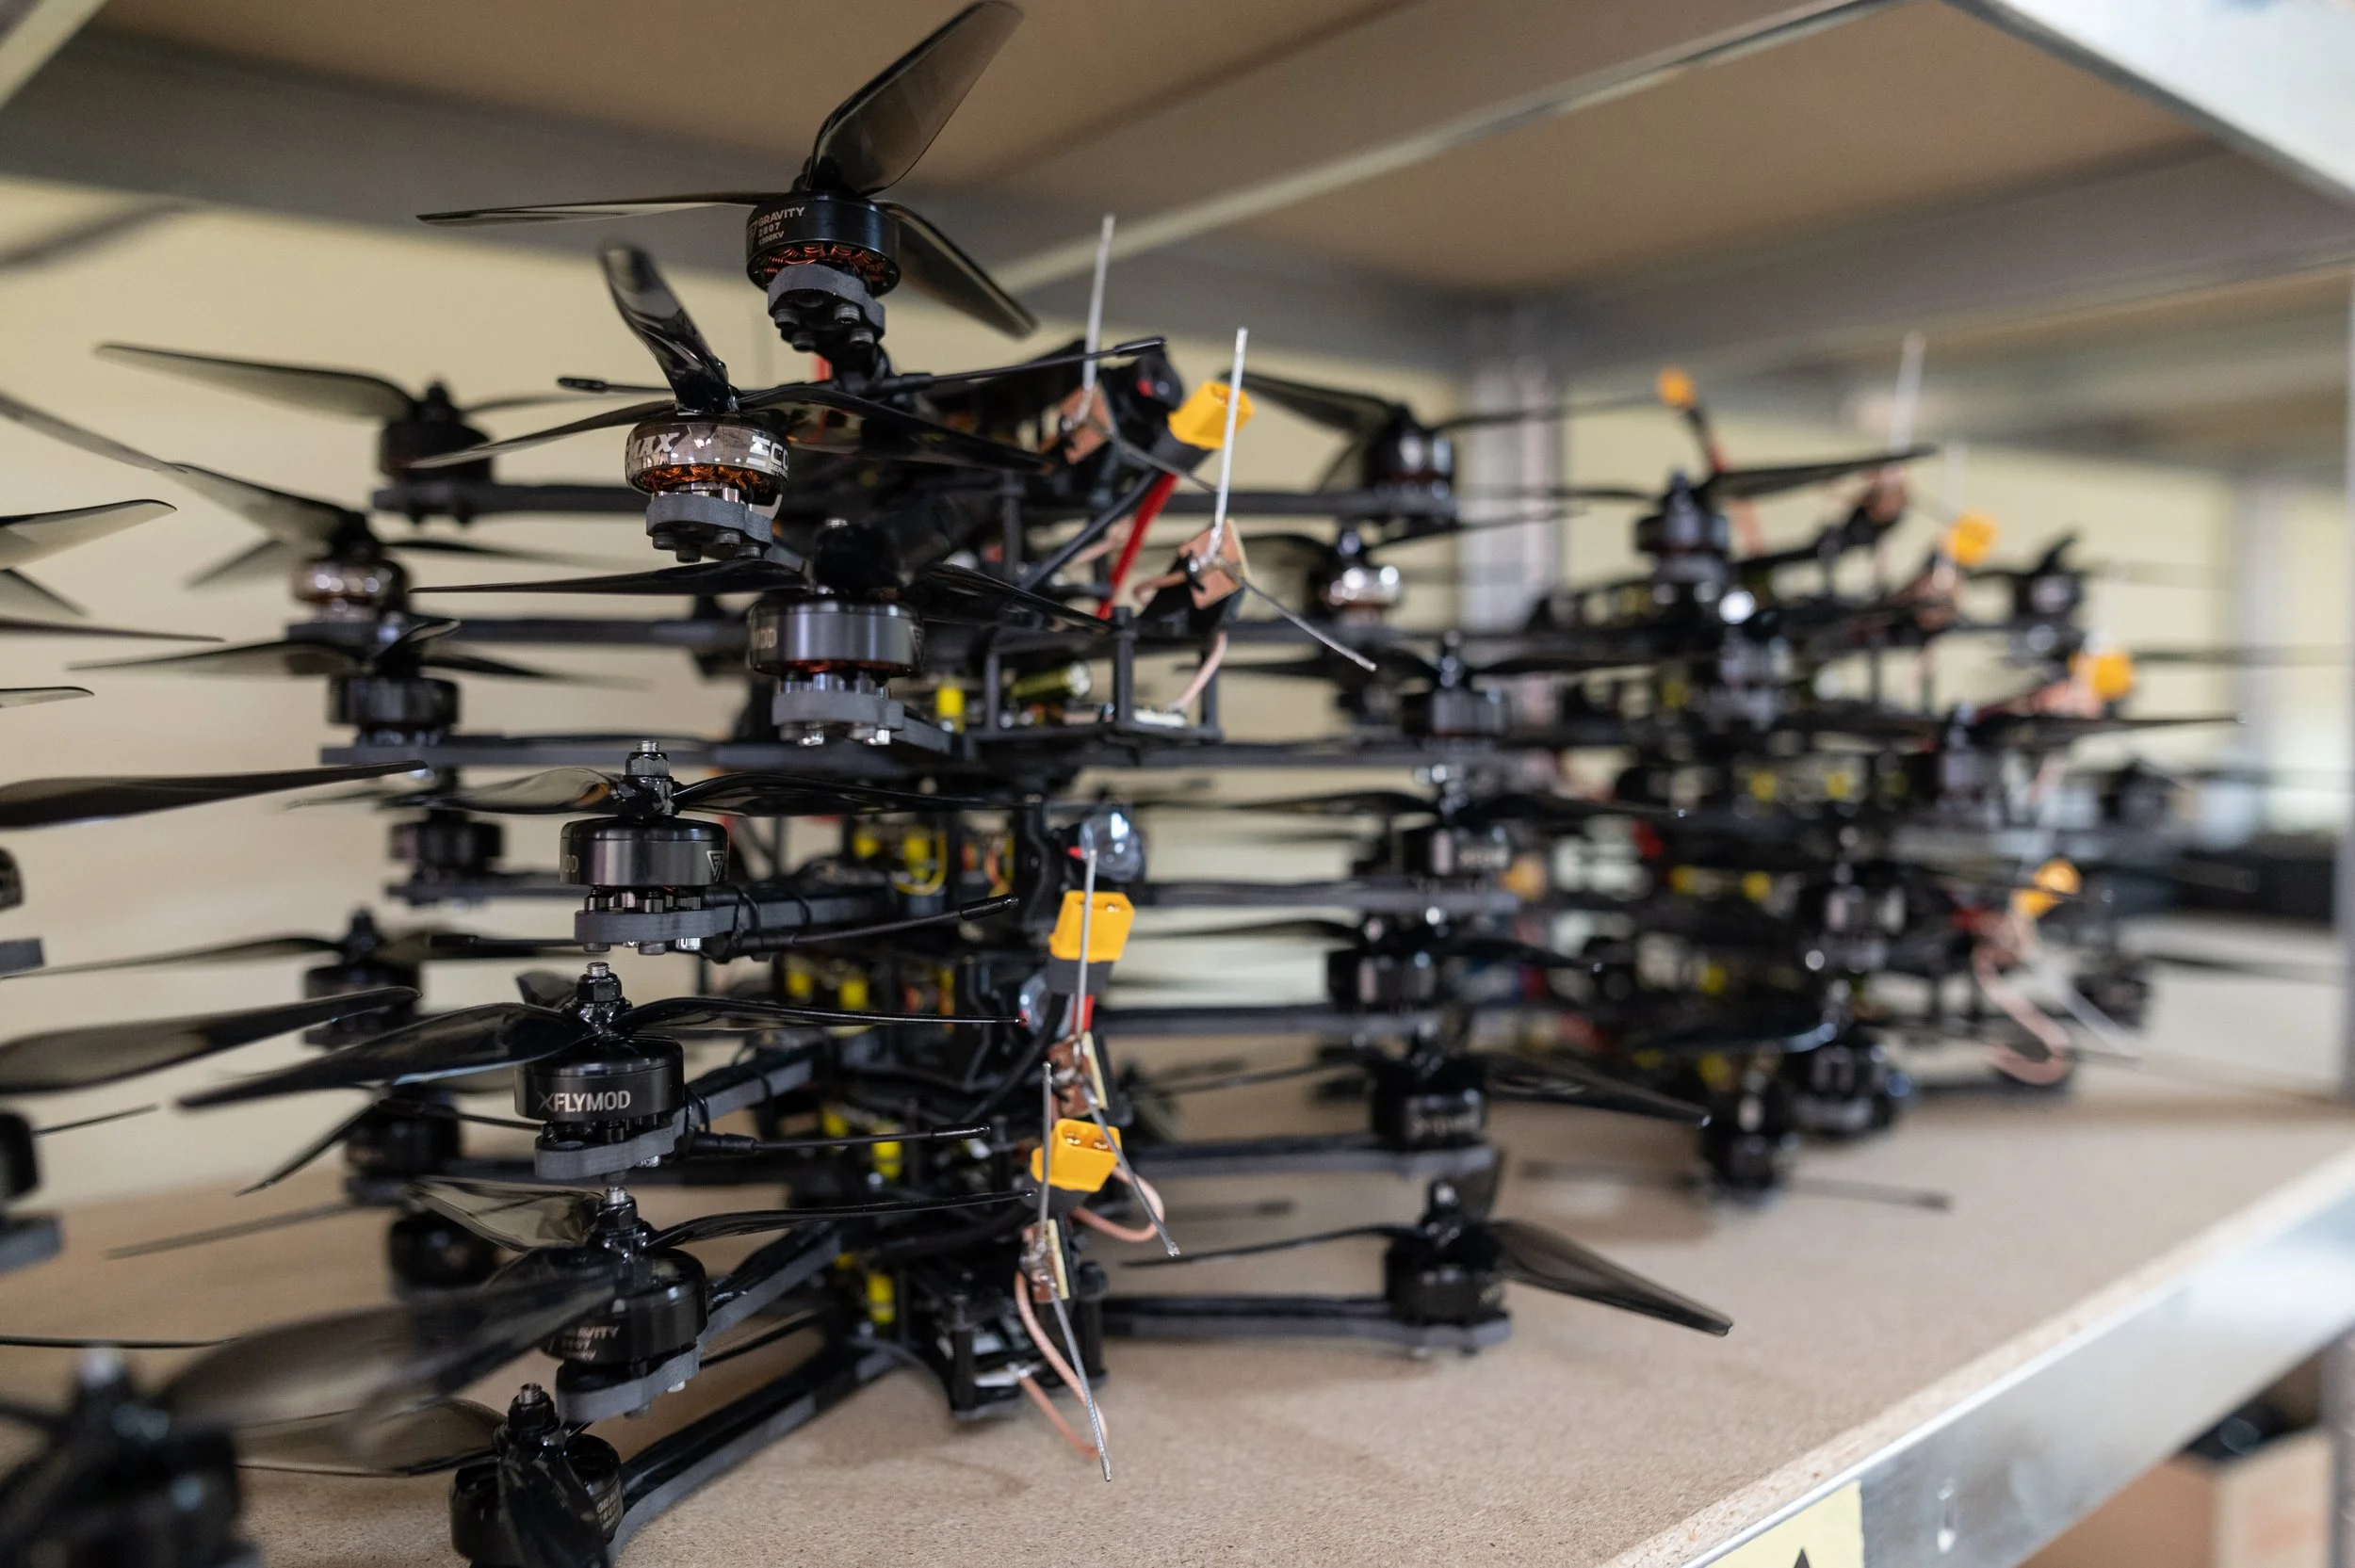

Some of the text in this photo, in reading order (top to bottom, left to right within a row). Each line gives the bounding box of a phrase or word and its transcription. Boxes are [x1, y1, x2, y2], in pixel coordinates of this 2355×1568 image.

[758, 206, 805, 227] GRAVITY
[746, 435, 789, 471] ECO
[537, 1090, 631, 1113] XFLYMOD
